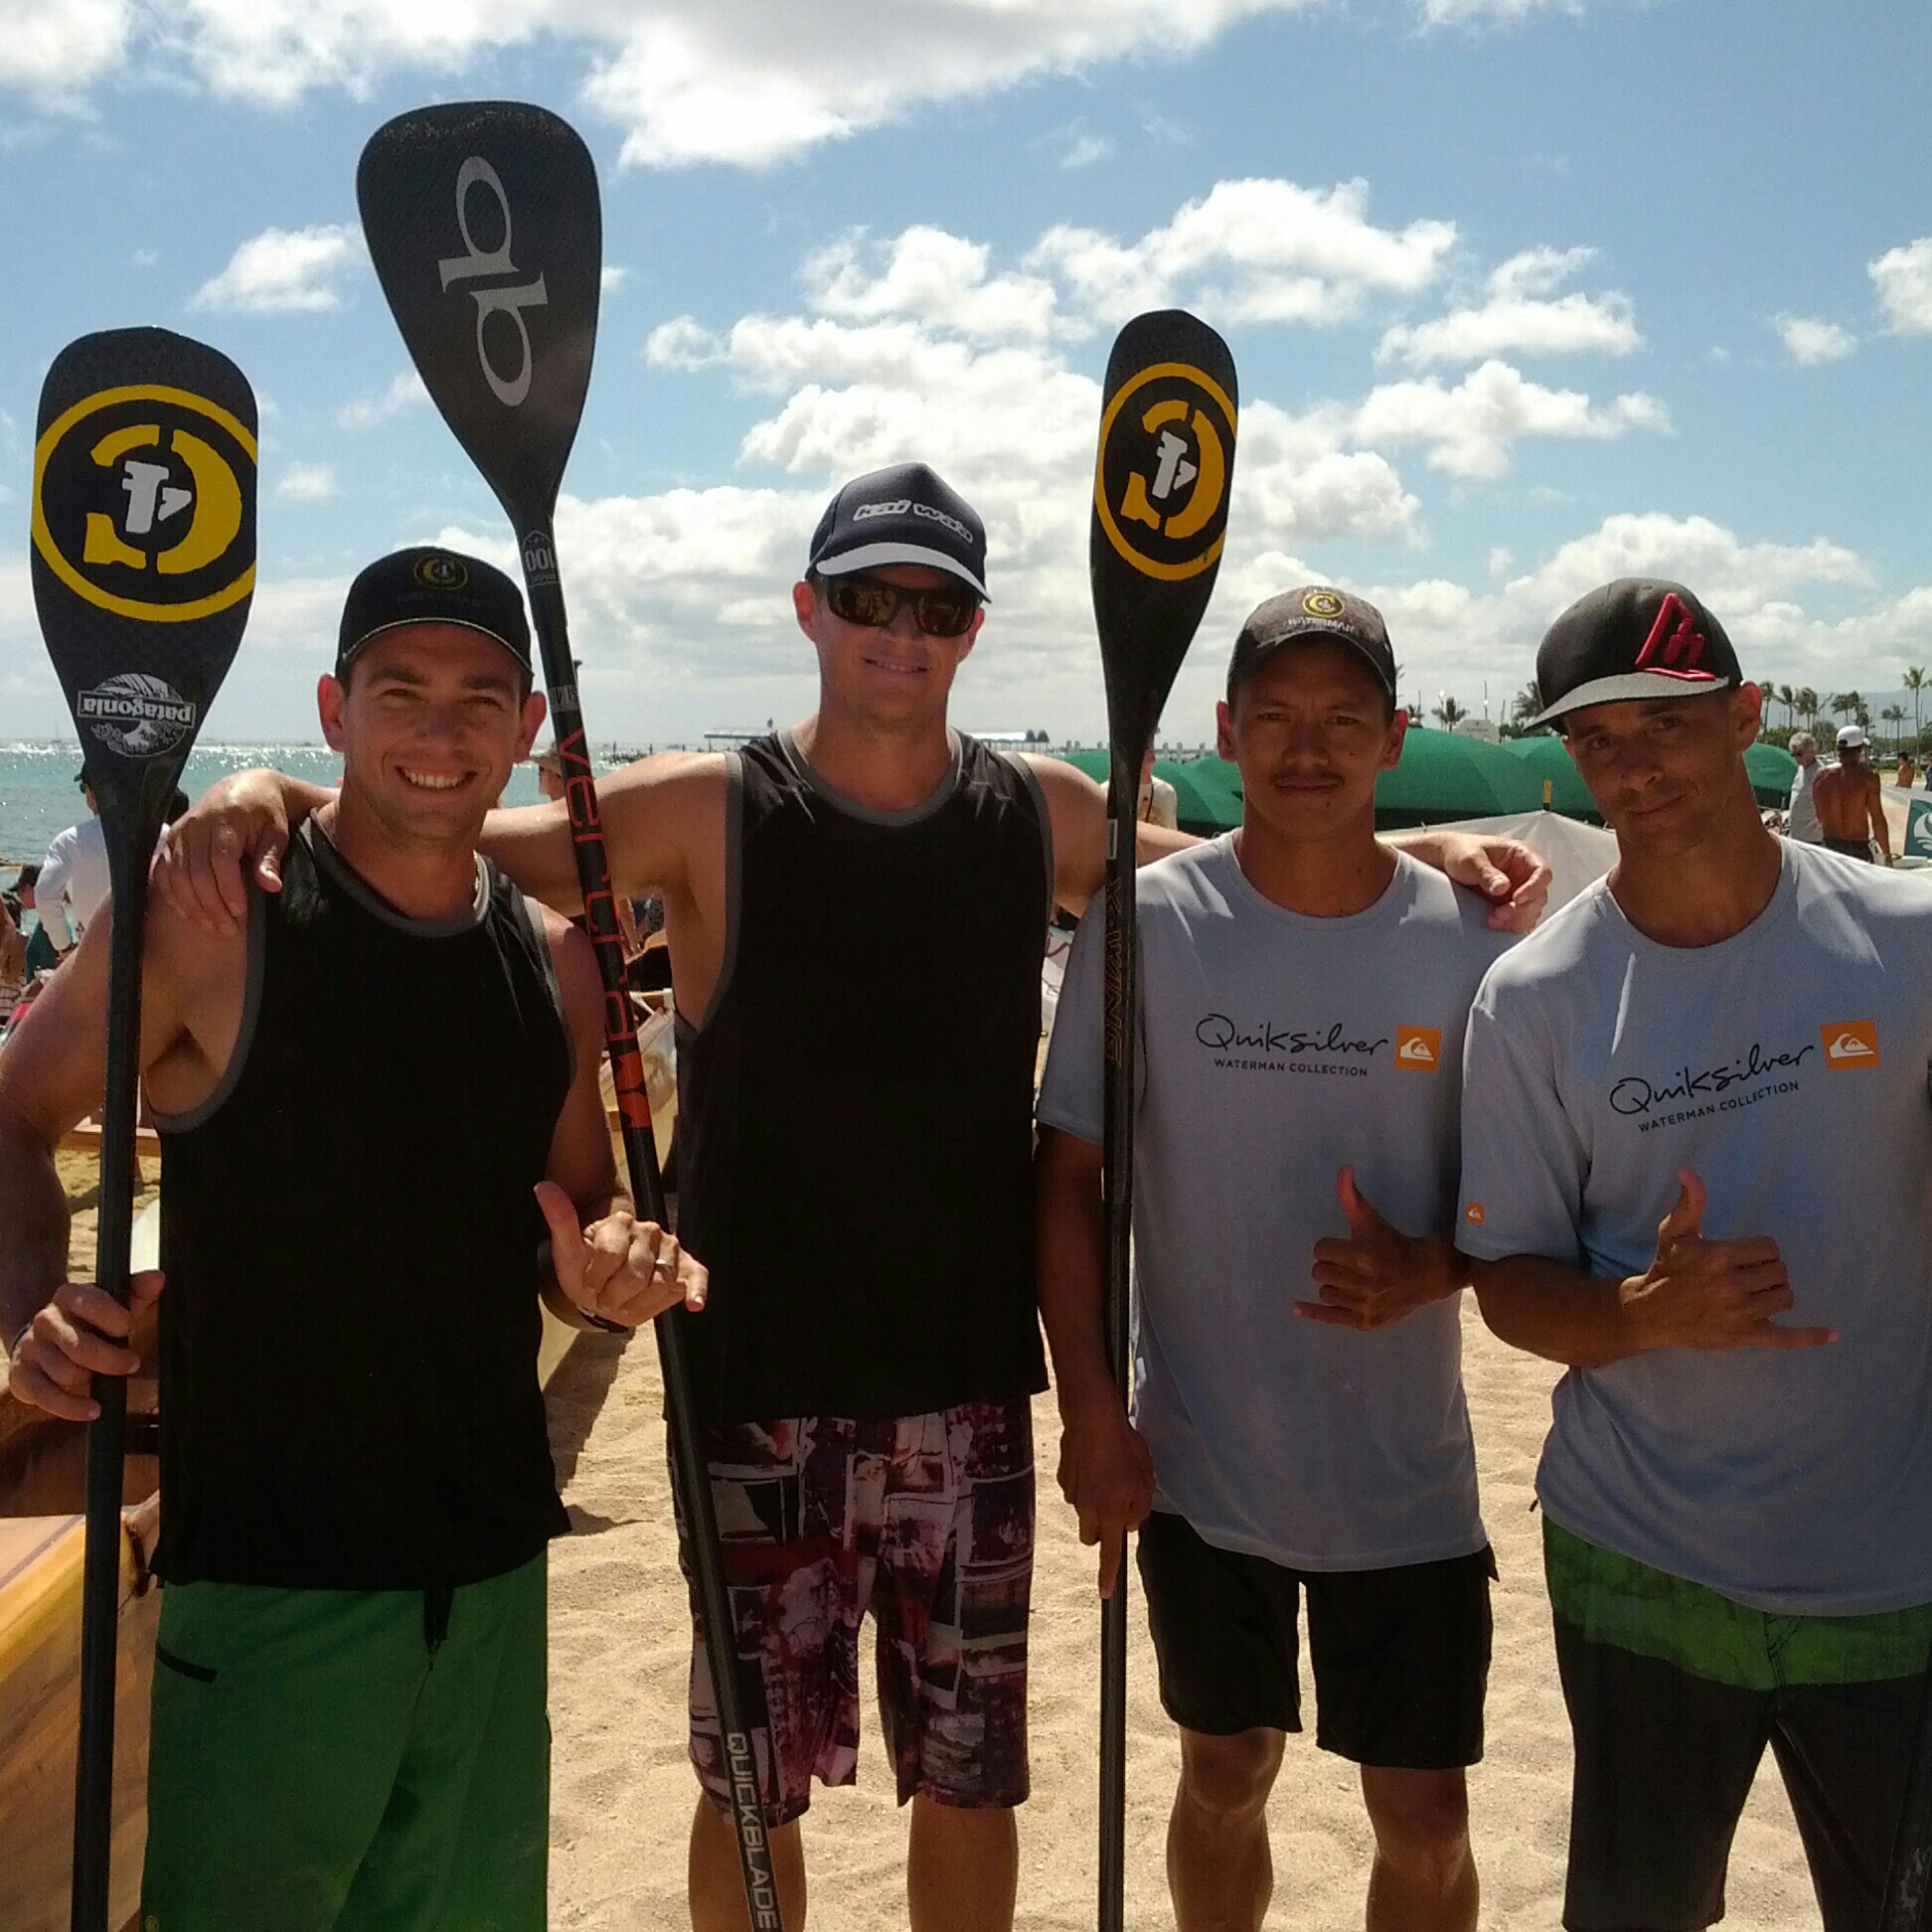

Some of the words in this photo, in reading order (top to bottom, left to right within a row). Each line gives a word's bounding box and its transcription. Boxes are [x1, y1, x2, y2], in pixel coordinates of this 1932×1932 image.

[83, 698, 192, 723] patagonia
[1196, 1013, 1388, 1056] Quiksilver
[1213, 1057, 1285, 1072] WATERMAN
[1289, 1061, 1368, 1077] COLLECTION
[1609, 1044, 1815, 1115] Quiksilver
[1638, 1104, 1715, 1133] WATERMAN
[1719, 1080, 1800, 1111] COLLECTION
[726, 1732, 779, 1930] QUICKBLADE
